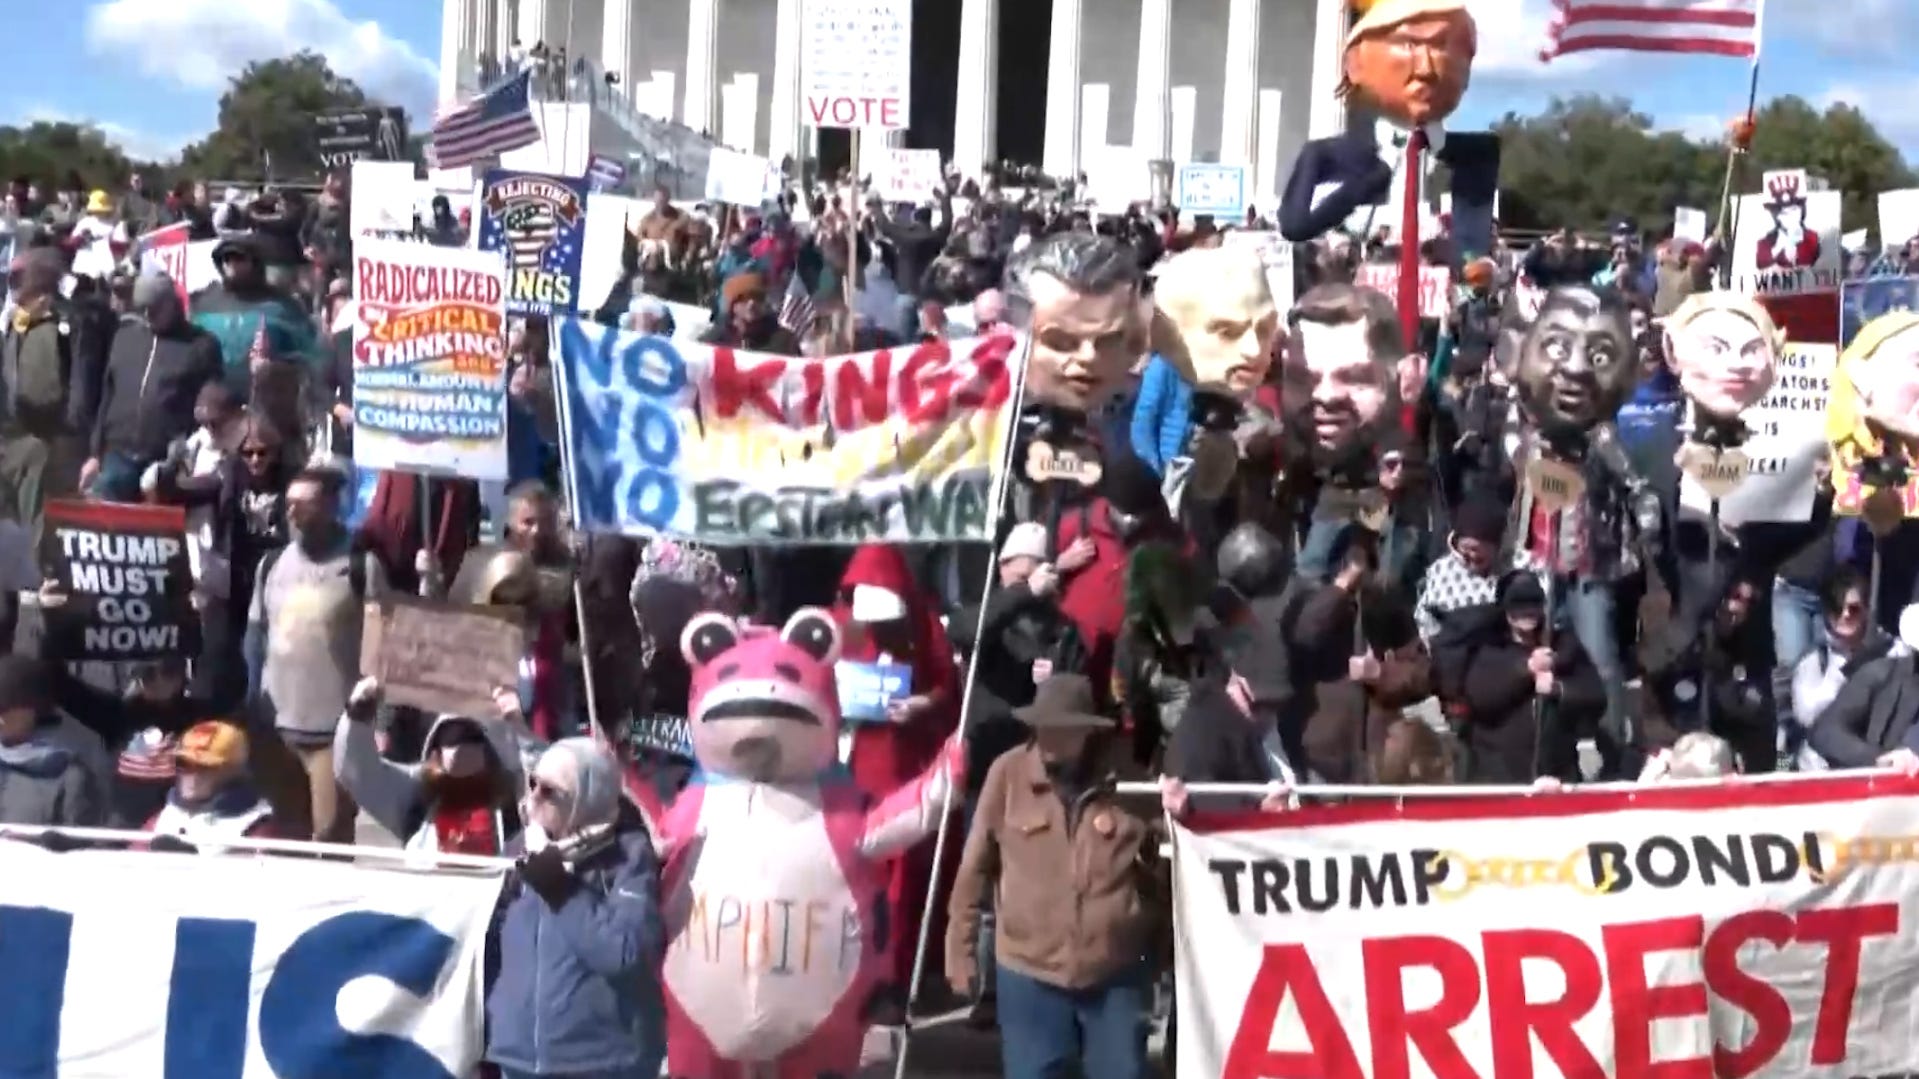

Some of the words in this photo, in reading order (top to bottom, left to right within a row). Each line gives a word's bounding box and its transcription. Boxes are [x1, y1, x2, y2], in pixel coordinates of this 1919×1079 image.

[807, 96, 900, 126] VOTE
[358, 256, 501, 304] RADICALIZED
[505, 268, 571, 304] INGS
[1753, 271, 1800, 292] WANT
[372, 307, 498, 343] CRITICAL
[362, 331, 505, 367] THINKING
[561, 318, 687, 396] NO
[713, 334, 1014, 430] KINGS
[358, 406, 500, 434] COMPASSION
[398, 392, 492, 412] HUMAN
[576, 458, 681, 531] NO
[55, 528, 180, 564] TRUMP
[70, 562, 170, 595] MUST
[98, 597, 152, 623] GO
[85, 625, 179, 650] NOW!
[1209, 847, 1449, 915] TRUMP
[1587, 830, 1824, 893] BONDI
[1221, 902, 1900, 1079] ARREST
